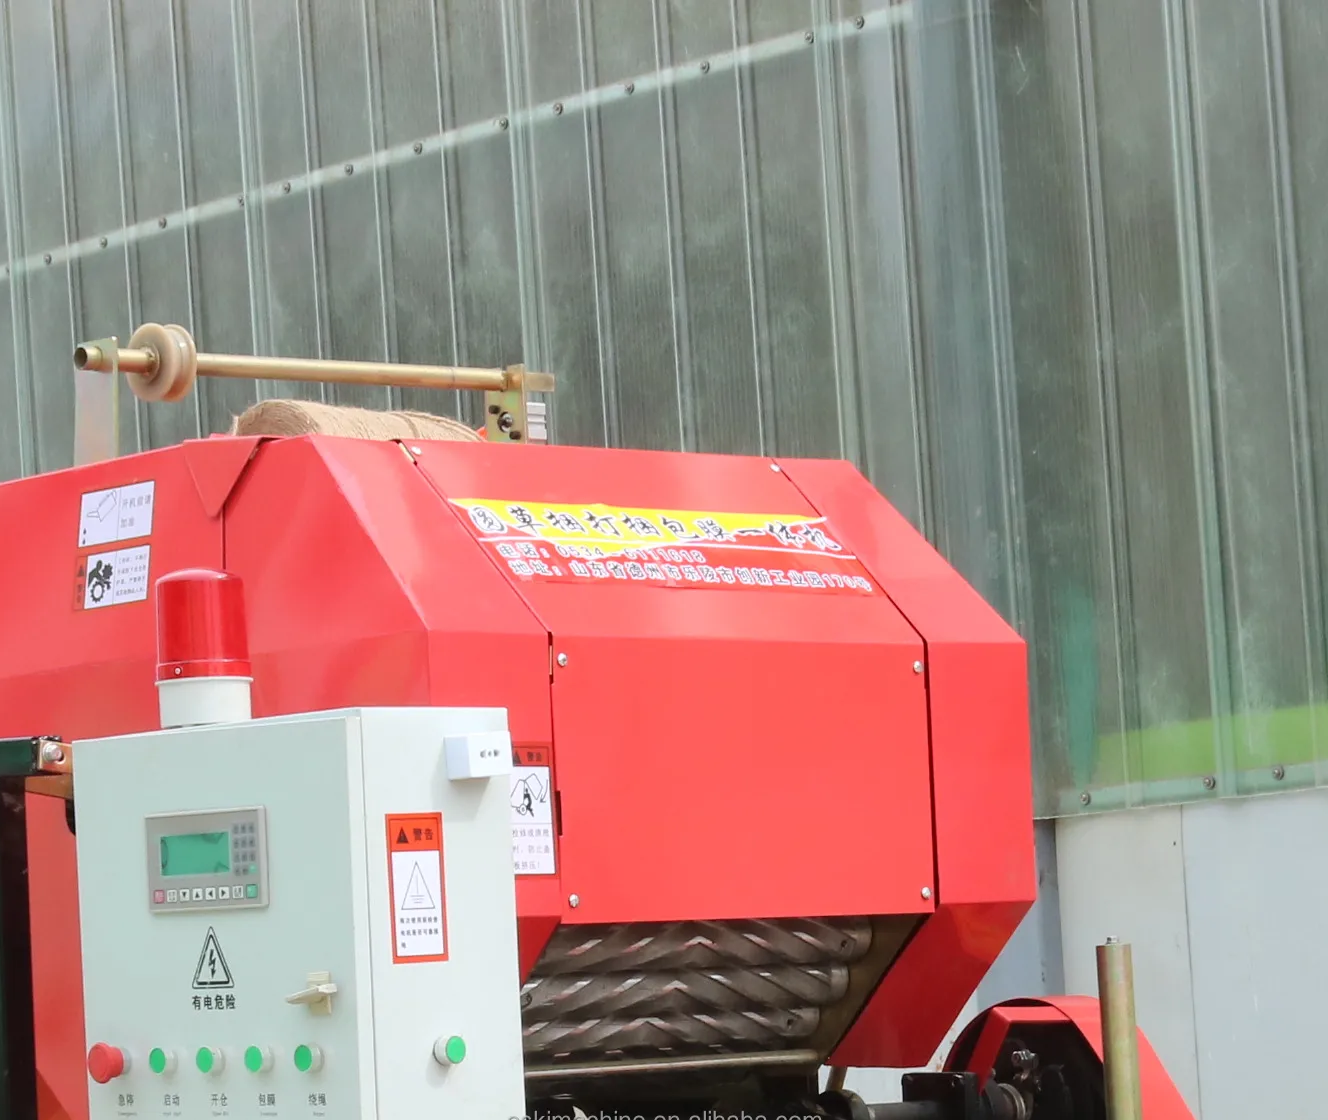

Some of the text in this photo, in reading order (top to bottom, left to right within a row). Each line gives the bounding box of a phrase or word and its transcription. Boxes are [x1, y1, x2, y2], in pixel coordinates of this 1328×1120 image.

[413, 828, 434, 841] 警告
[191, 993, 236, 1011] 有电危险
[118, 1094, 134, 1107] 急停
[164, 1094, 180, 1106] 启动
[211, 1093, 228, 1107] 开仓
[258, 1093, 276, 1106] 包膜
[308, 1093, 326, 1106] 绕绳
